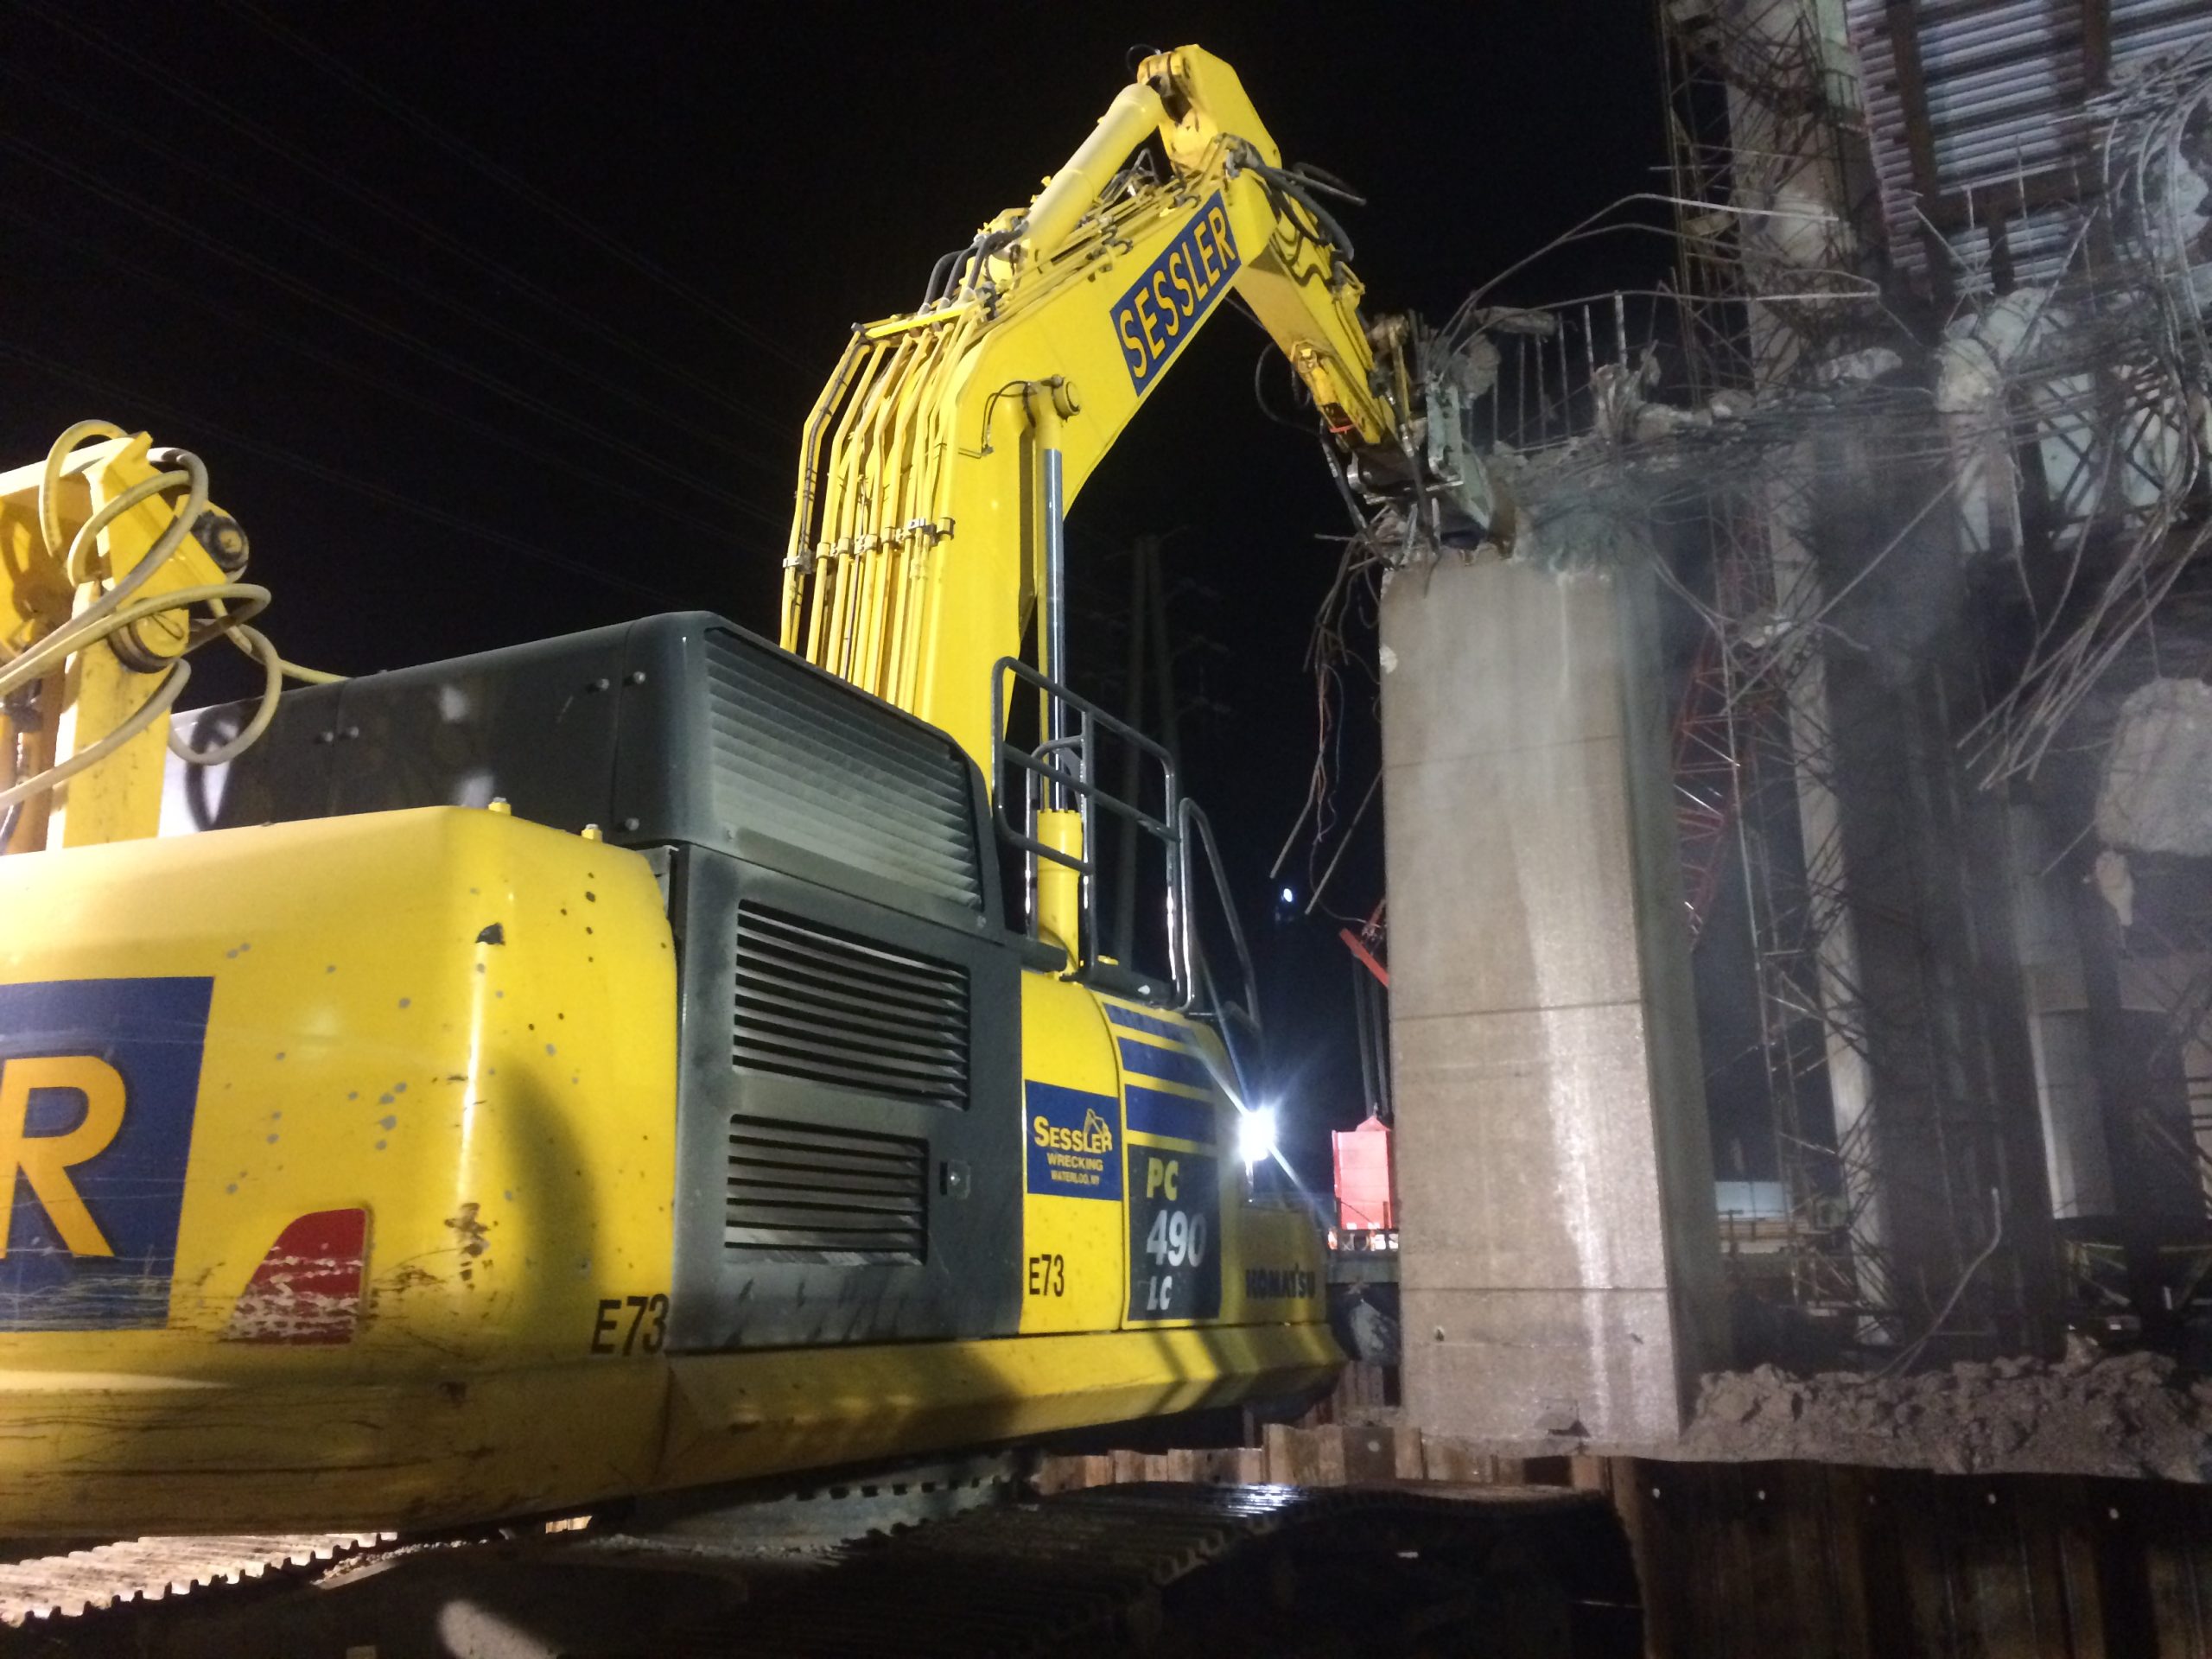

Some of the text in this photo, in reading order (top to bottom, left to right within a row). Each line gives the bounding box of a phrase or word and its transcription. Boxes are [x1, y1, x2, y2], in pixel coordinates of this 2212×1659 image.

[1119, 206, 1236, 378] SESSLER
[1033, 1116, 1113, 1154] SESSLER
[1046, 1152, 1103, 1172] WRECKING
[1147, 1157, 1179, 1201] PC
[1146, 1210, 1207, 1268] 490
[1029, 1254, 1064, 1297] E73
[1147, 1275, 1173, 1311] LC
[591, 1293, 670, 1357] E73
